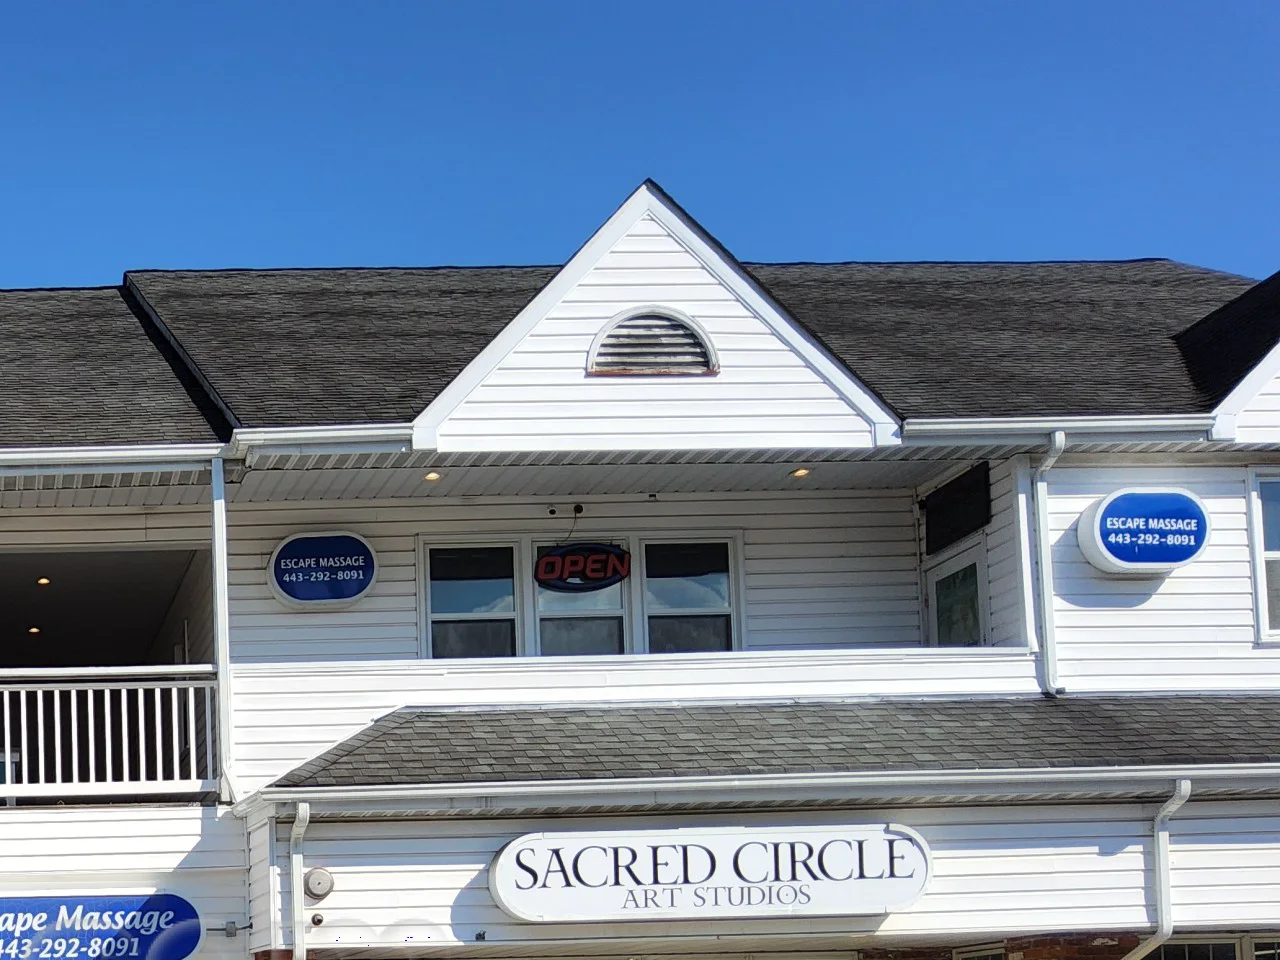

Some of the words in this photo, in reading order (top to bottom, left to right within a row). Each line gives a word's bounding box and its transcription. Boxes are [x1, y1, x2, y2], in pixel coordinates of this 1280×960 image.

[1106, 517, 1146, 529] ESCAPE
[1148, 518, 1198, 530] MASSAGE
[1108, 533, 1196, 545] 443-292-8091
[280, 558, 317, 569] ESCAPE
[319, 556, 365, 567] MASSAGE
[537, 552, 631, 579] OPEN
[283, 570, 365, 582] 443-292-8091
[514, 843, 717, 890] SACRED
[732, 838, 916, 885] CIRCLE
[621, 887, 683, 909] ART
[693, 884, 812, 907] STUDIOS
[55, 905, 175, 936] Massage
